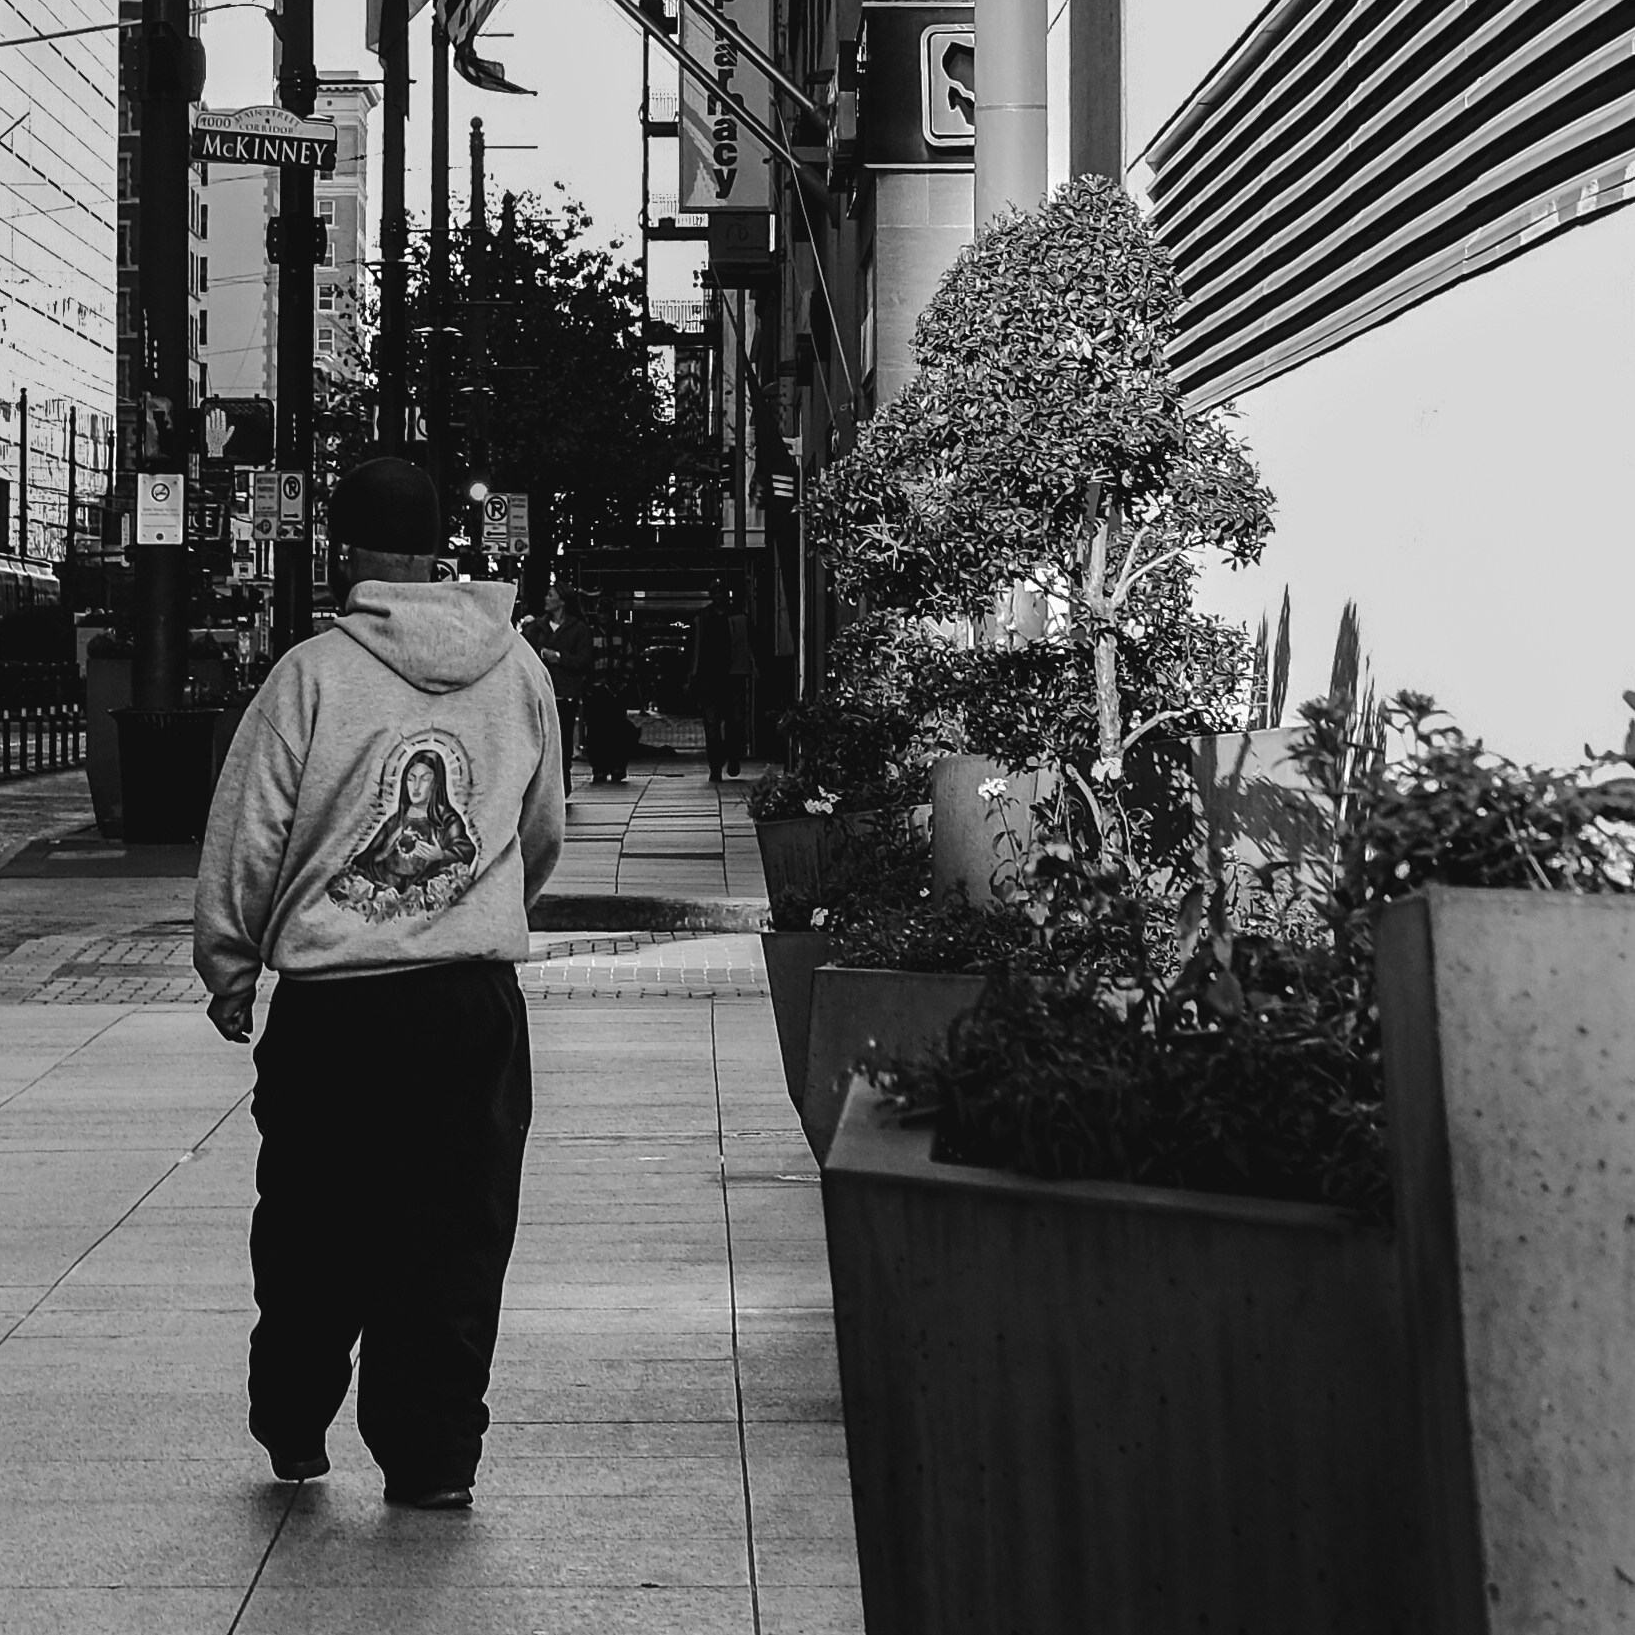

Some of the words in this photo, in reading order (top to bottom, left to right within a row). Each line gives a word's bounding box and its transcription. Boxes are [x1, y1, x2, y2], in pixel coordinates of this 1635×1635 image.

[234, 109, 262, 123] MAIN
[265, 109, 300, 127] STREET
[238, 124, 294, 134] CORRIDOR
[202, 133, 328, 166] McKINNEY
